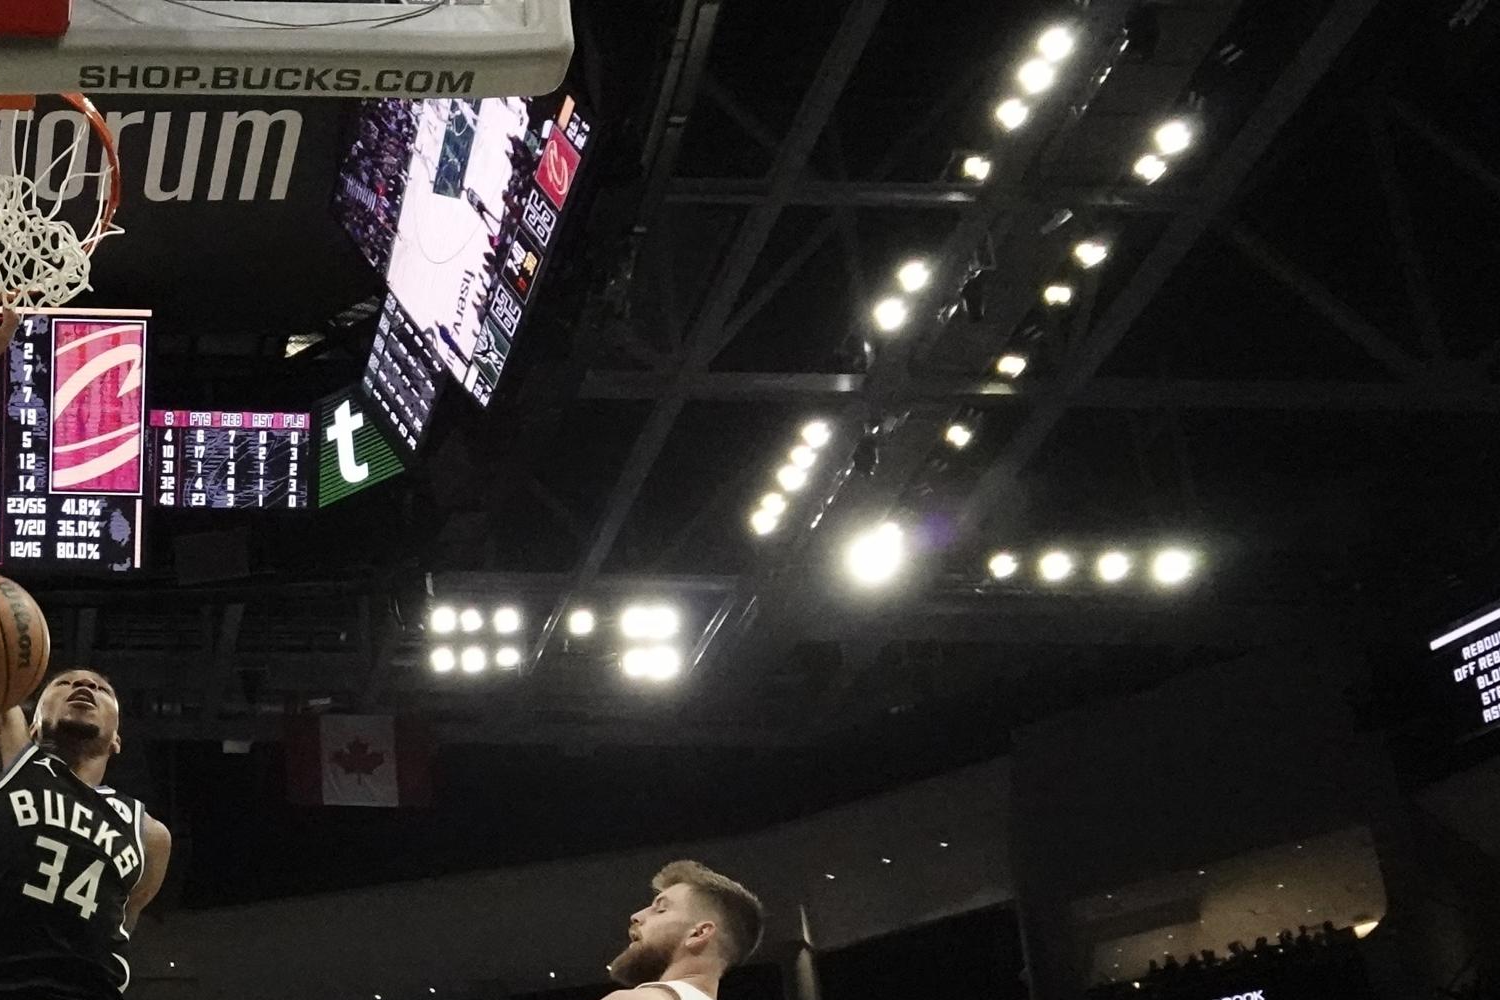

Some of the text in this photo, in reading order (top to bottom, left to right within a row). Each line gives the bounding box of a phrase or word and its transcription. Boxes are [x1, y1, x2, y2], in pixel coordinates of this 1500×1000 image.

[77, 63, 476, 96] SHOP.BUCKS.COM
[24, 320, 33, 336] 7
[24, 343, 33, 359] 2
[23, 364, 33, 382] 7
[22, 386, 33, 403] 7
[20, 408, 37, 426] 19
[190, 412, 211, 426] PTS
[222, 412, 242, 427] REB
[252, 413, 274, 428] AST
[284, 414, 305, 428] FLS
[23, 432, 31, 447] 5
[164, 428, 173, 442] 4
[162, 445, 205, 458] 10 17
[20, 454, 35, 469] 12
[162, 460, 174, 473] 31
[19, 476, 35, 491] 14
[160, 476, 175, 490] 32
[7, 498, 46, 513] 23/55
[62, 499, 100, 515] 41.8%
[159, 492, 206, 506] 45 23
[15, 519, 45, 535] 7/20
[58, 520, 100, 537] 35.0%
[11, 542, 40, 557] 12/15
[57, 543, 99, 559] 80.0%
[1453, 661, 1476, 682] OFF
[10, 787, 141, 880] BUCKS
[22, 835, 107, 922] 34
